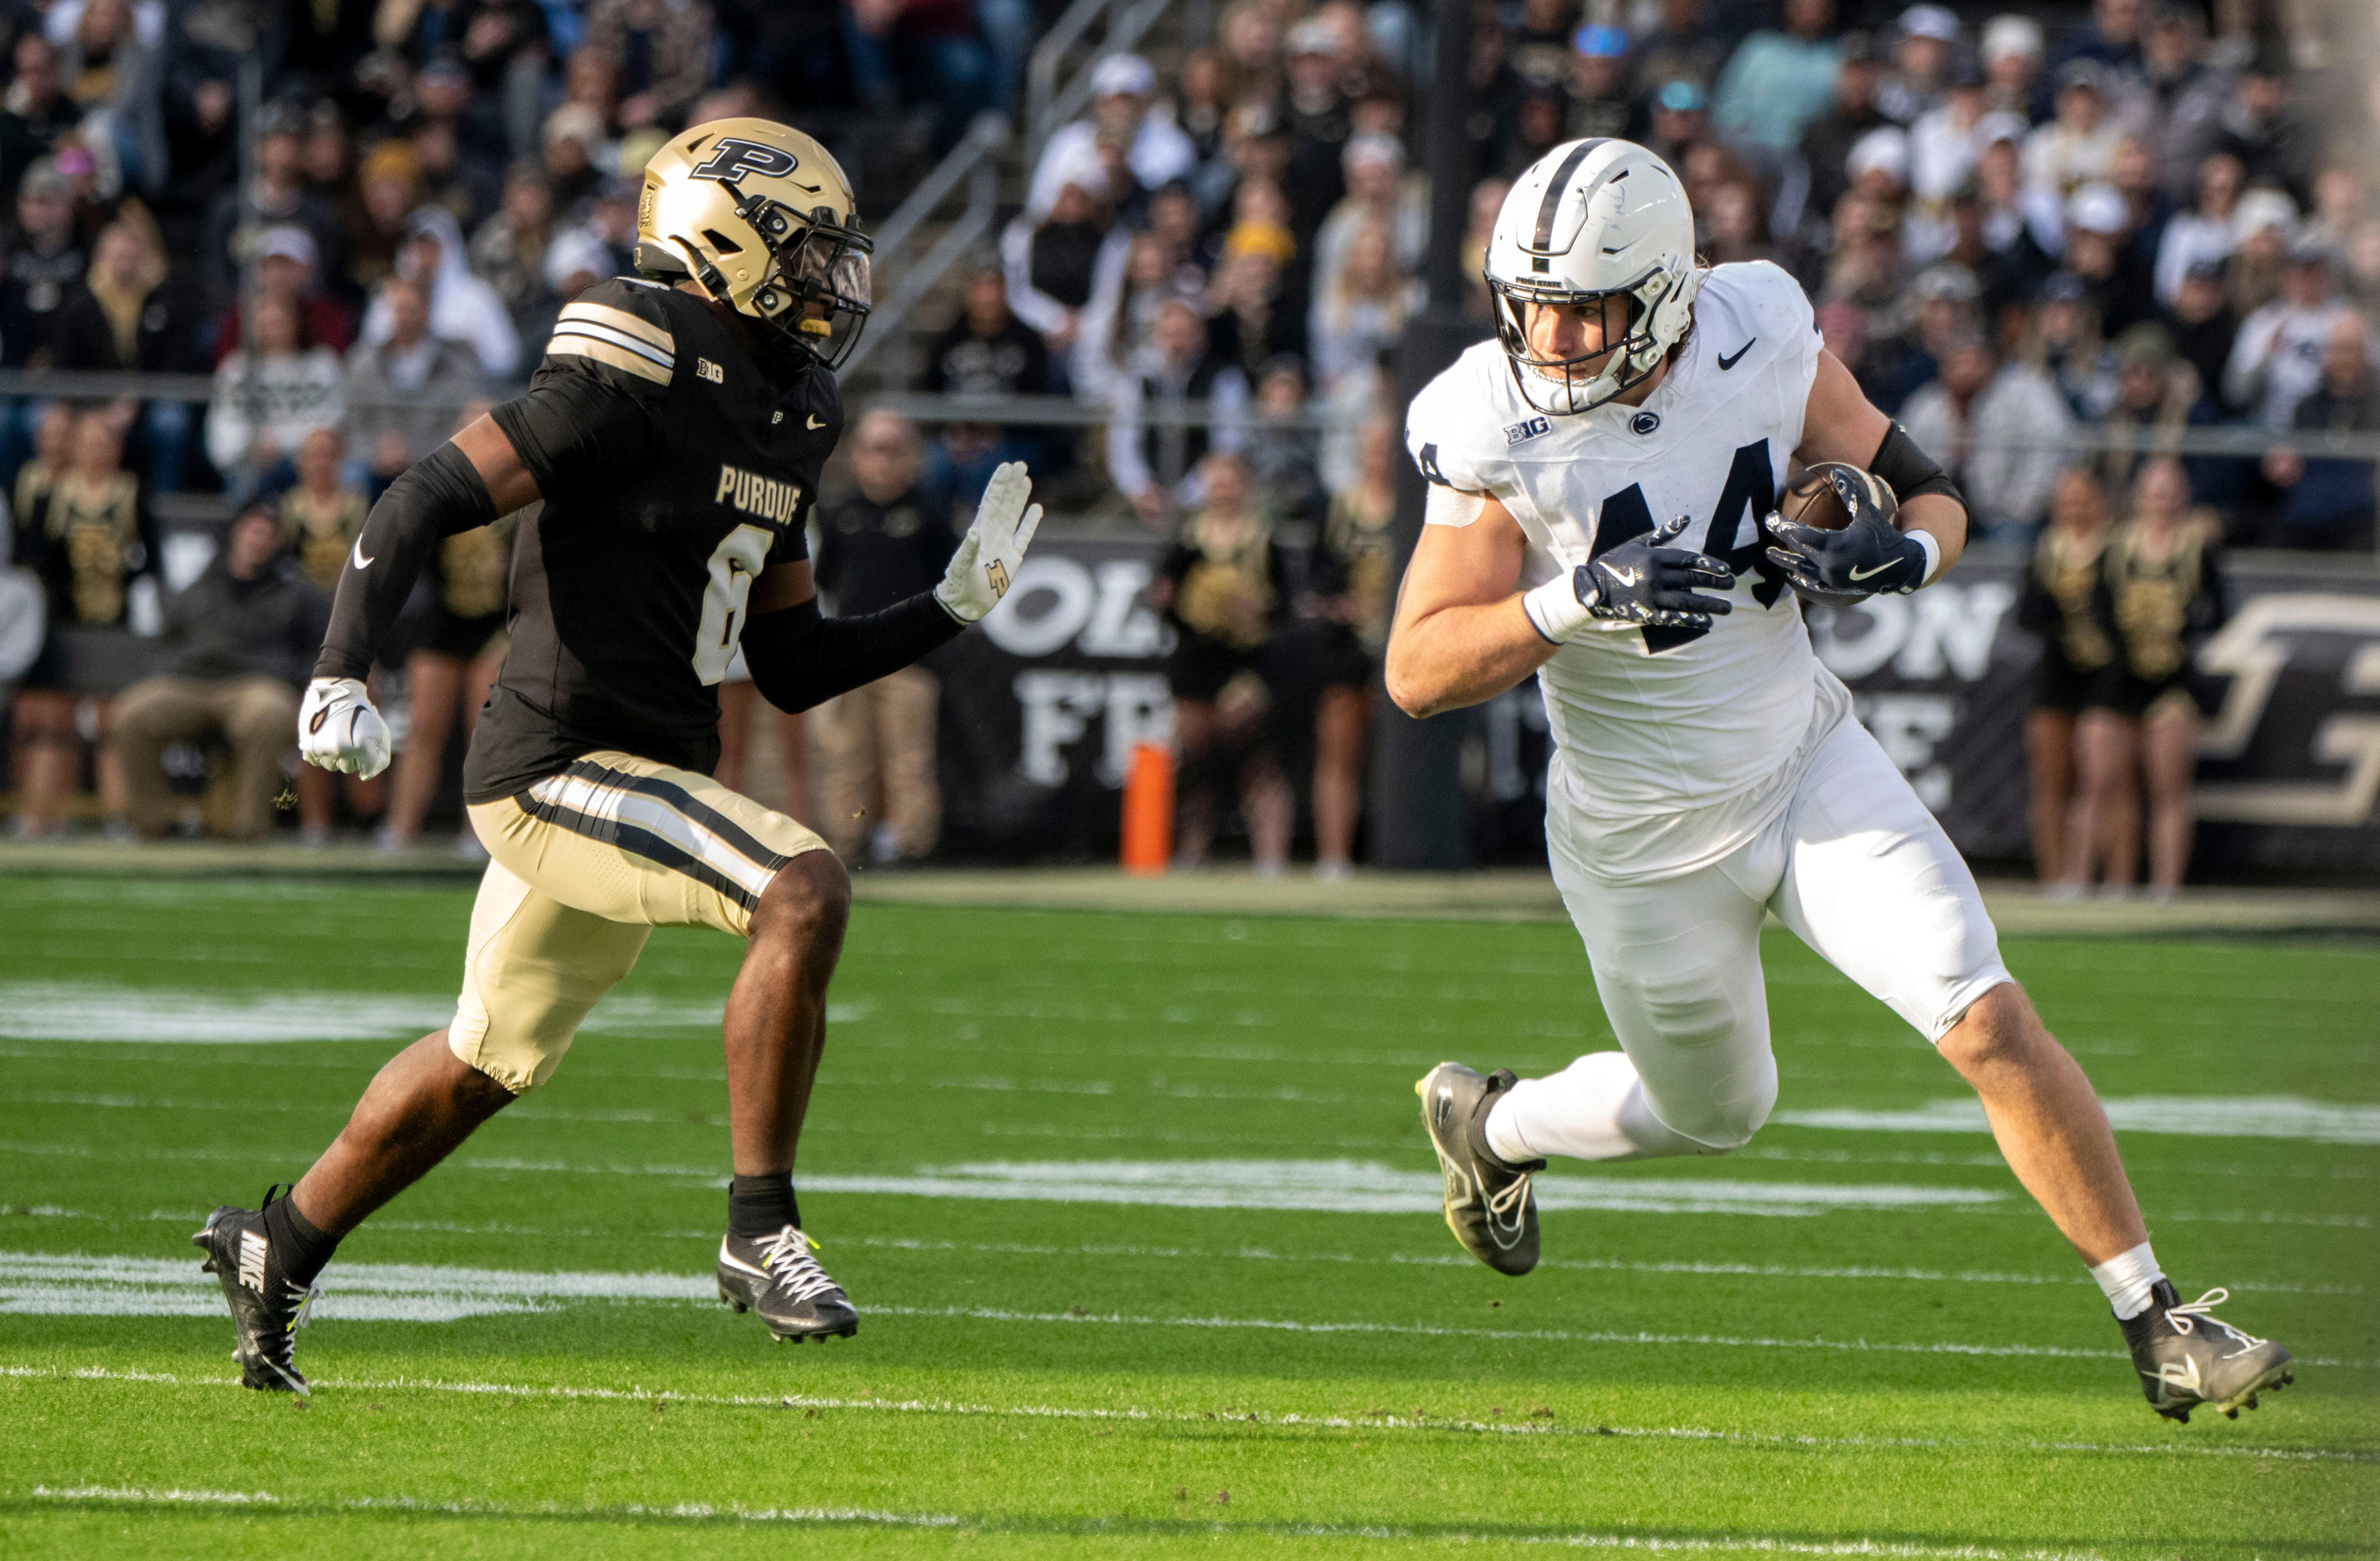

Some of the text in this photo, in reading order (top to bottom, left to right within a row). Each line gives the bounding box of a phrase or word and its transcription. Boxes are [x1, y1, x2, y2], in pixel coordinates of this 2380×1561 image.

[687, 137, 799, 185] P
[696, 357, 723, 384] BIG
[771, 411, 783, 424] P
[1504, 416, 1550, 445] BIG
[714, 463, 802, 527] PURDUE
[984, 558, 1010, 599] P
[239, 1228, 268, 1294] NIKE
